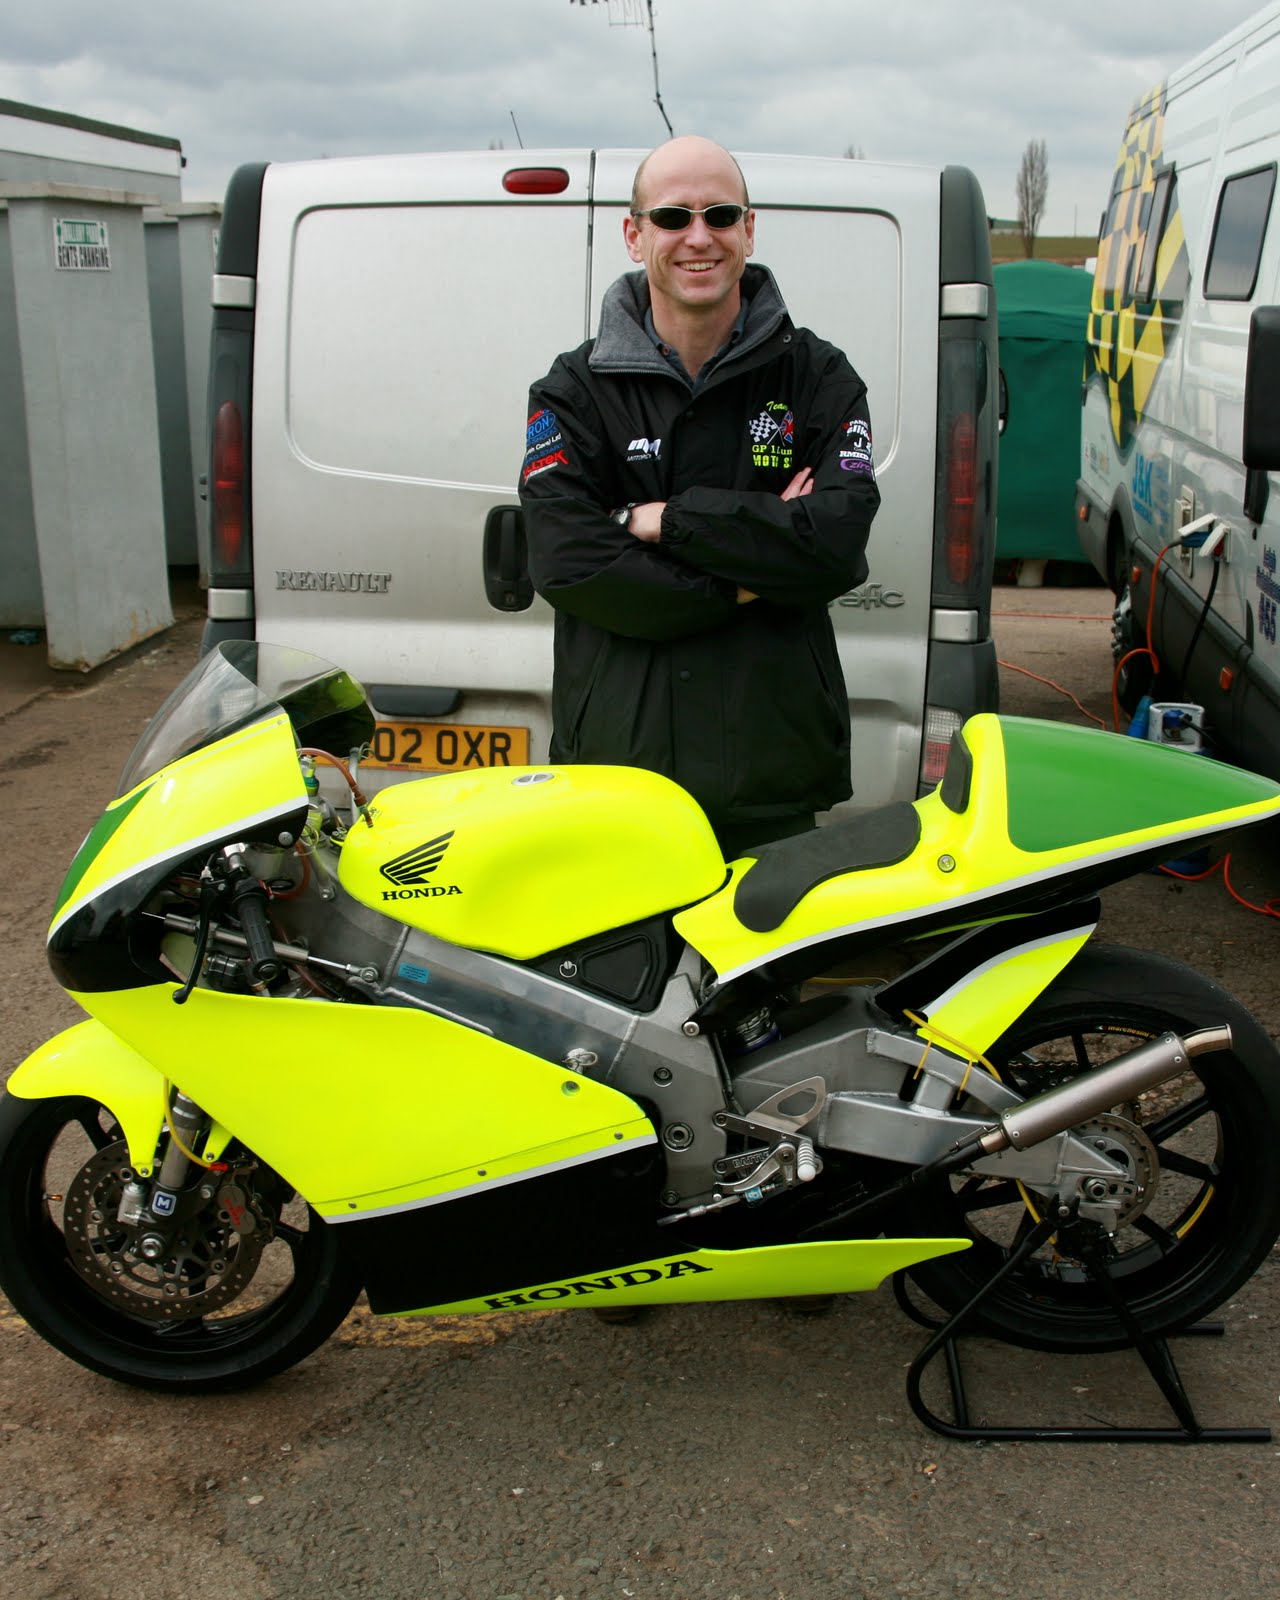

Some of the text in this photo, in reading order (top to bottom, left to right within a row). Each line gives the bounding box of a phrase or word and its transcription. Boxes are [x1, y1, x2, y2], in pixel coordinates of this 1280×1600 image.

[58, 245, 110, 268] GENTS CHANGING
[752, 444, 767, 453] GP
[275, 569, 392, 593] RENAULT
[828, 582, 904, 610] afic
[436, 730, 512, 767] OXR
[381, 885, 463, 900] HONDA
[483, 1260, 713, 1309] HONDA
